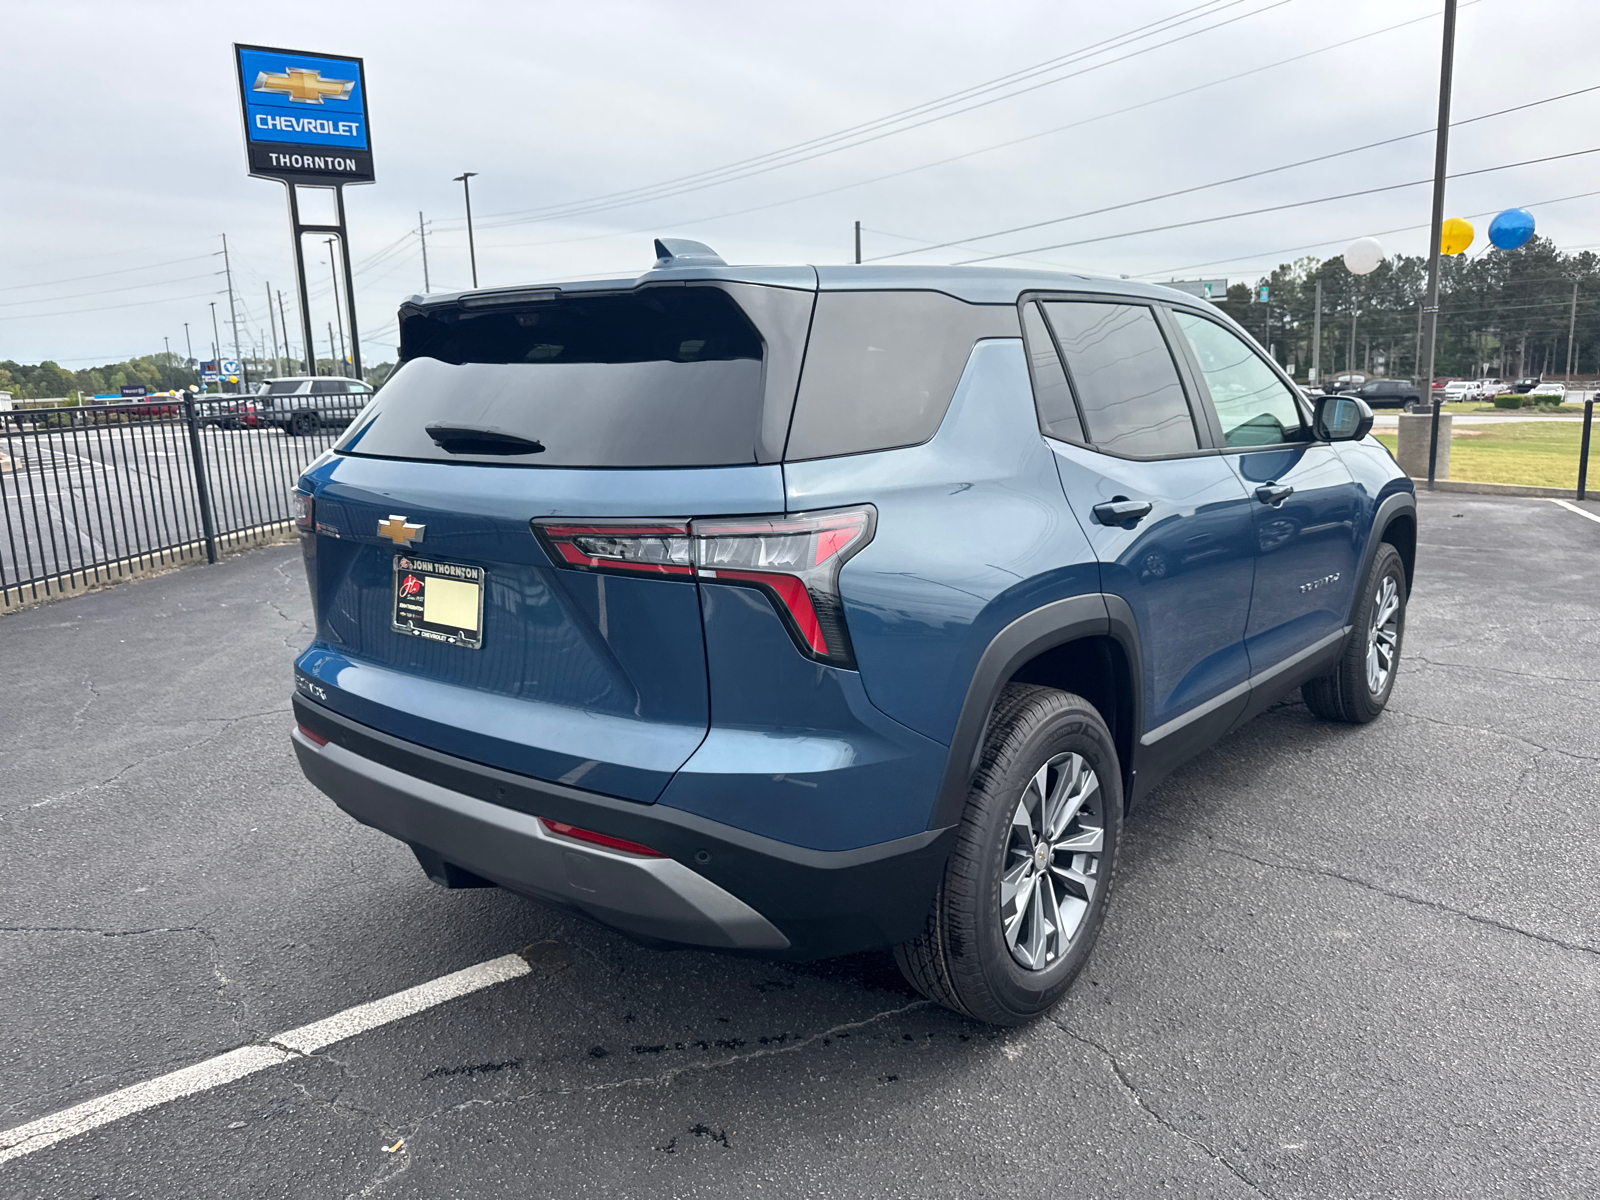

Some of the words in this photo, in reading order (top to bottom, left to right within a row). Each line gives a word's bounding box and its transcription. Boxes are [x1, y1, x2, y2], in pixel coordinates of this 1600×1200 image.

[255, 114, 359, 136] CHEVROLET
[269, 153, 356, 171] THORNTON
[413, 560, 433, 572] JOHN
[434, 563, 478, 579] THORNTON
[421, 631, 447, 641] CHEVROLET
